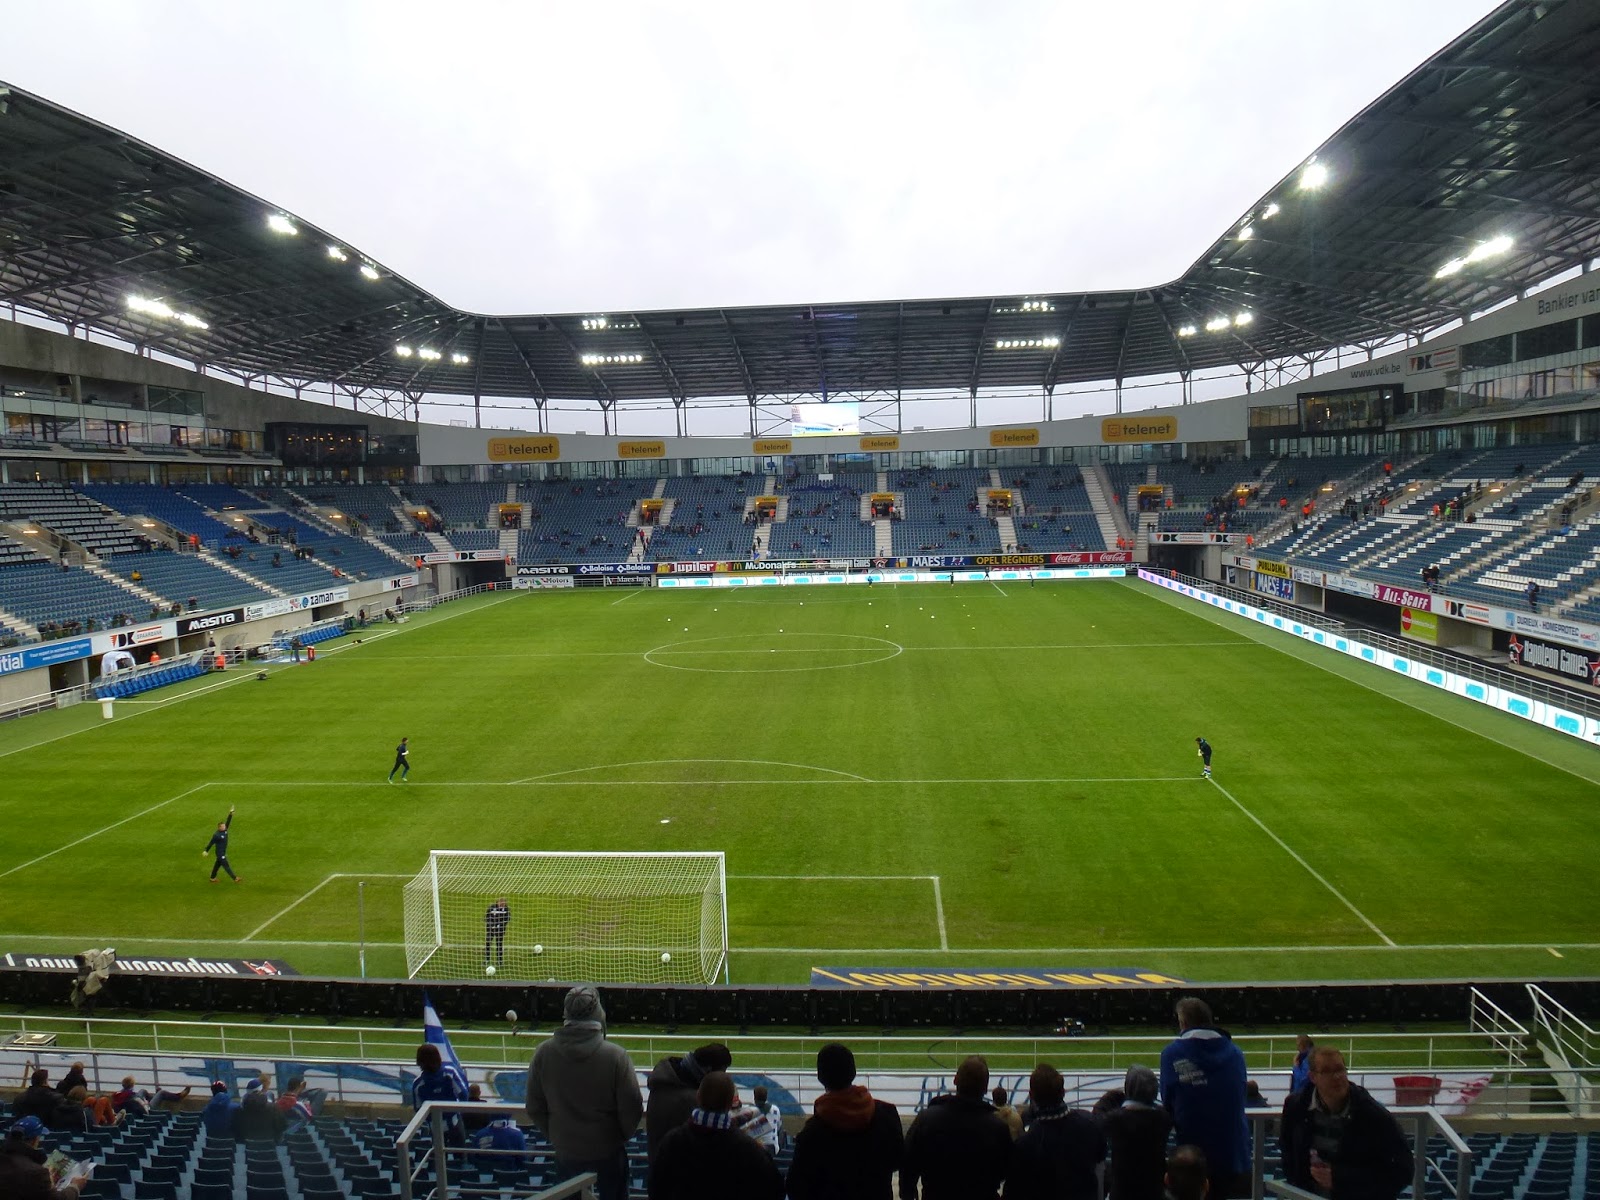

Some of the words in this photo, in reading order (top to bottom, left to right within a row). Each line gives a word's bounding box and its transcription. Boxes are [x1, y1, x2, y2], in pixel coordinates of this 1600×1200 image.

[1538, 293, 1579, 315] Bankier
[1350, 364, 1401, 379] www.vdk.be
[1123, 424, 1171, 435] telenet
[1004, 433, 1035, 442] telenet
[509, 443, 554, 455] telenet
[631, 446, 662, 454] telenet
[764, 443, 789, 451] telenet
[912, 556, 941, 567] MAES
[976, 556, 999, 565] OPEL
[1001, 555, 1044, 565] REGNIERS
[673, 562, 714, 572] Jupiler
[1258, 560, 1287, 575] PUBLIDEMA
[1258, 572, 1276, 595] MAES
[310, 592, 335, 606] zaman
[1517, 616, 1538, 629] DURIEUX
[1542, 621, 1580, 636] HOMEPROTEC
